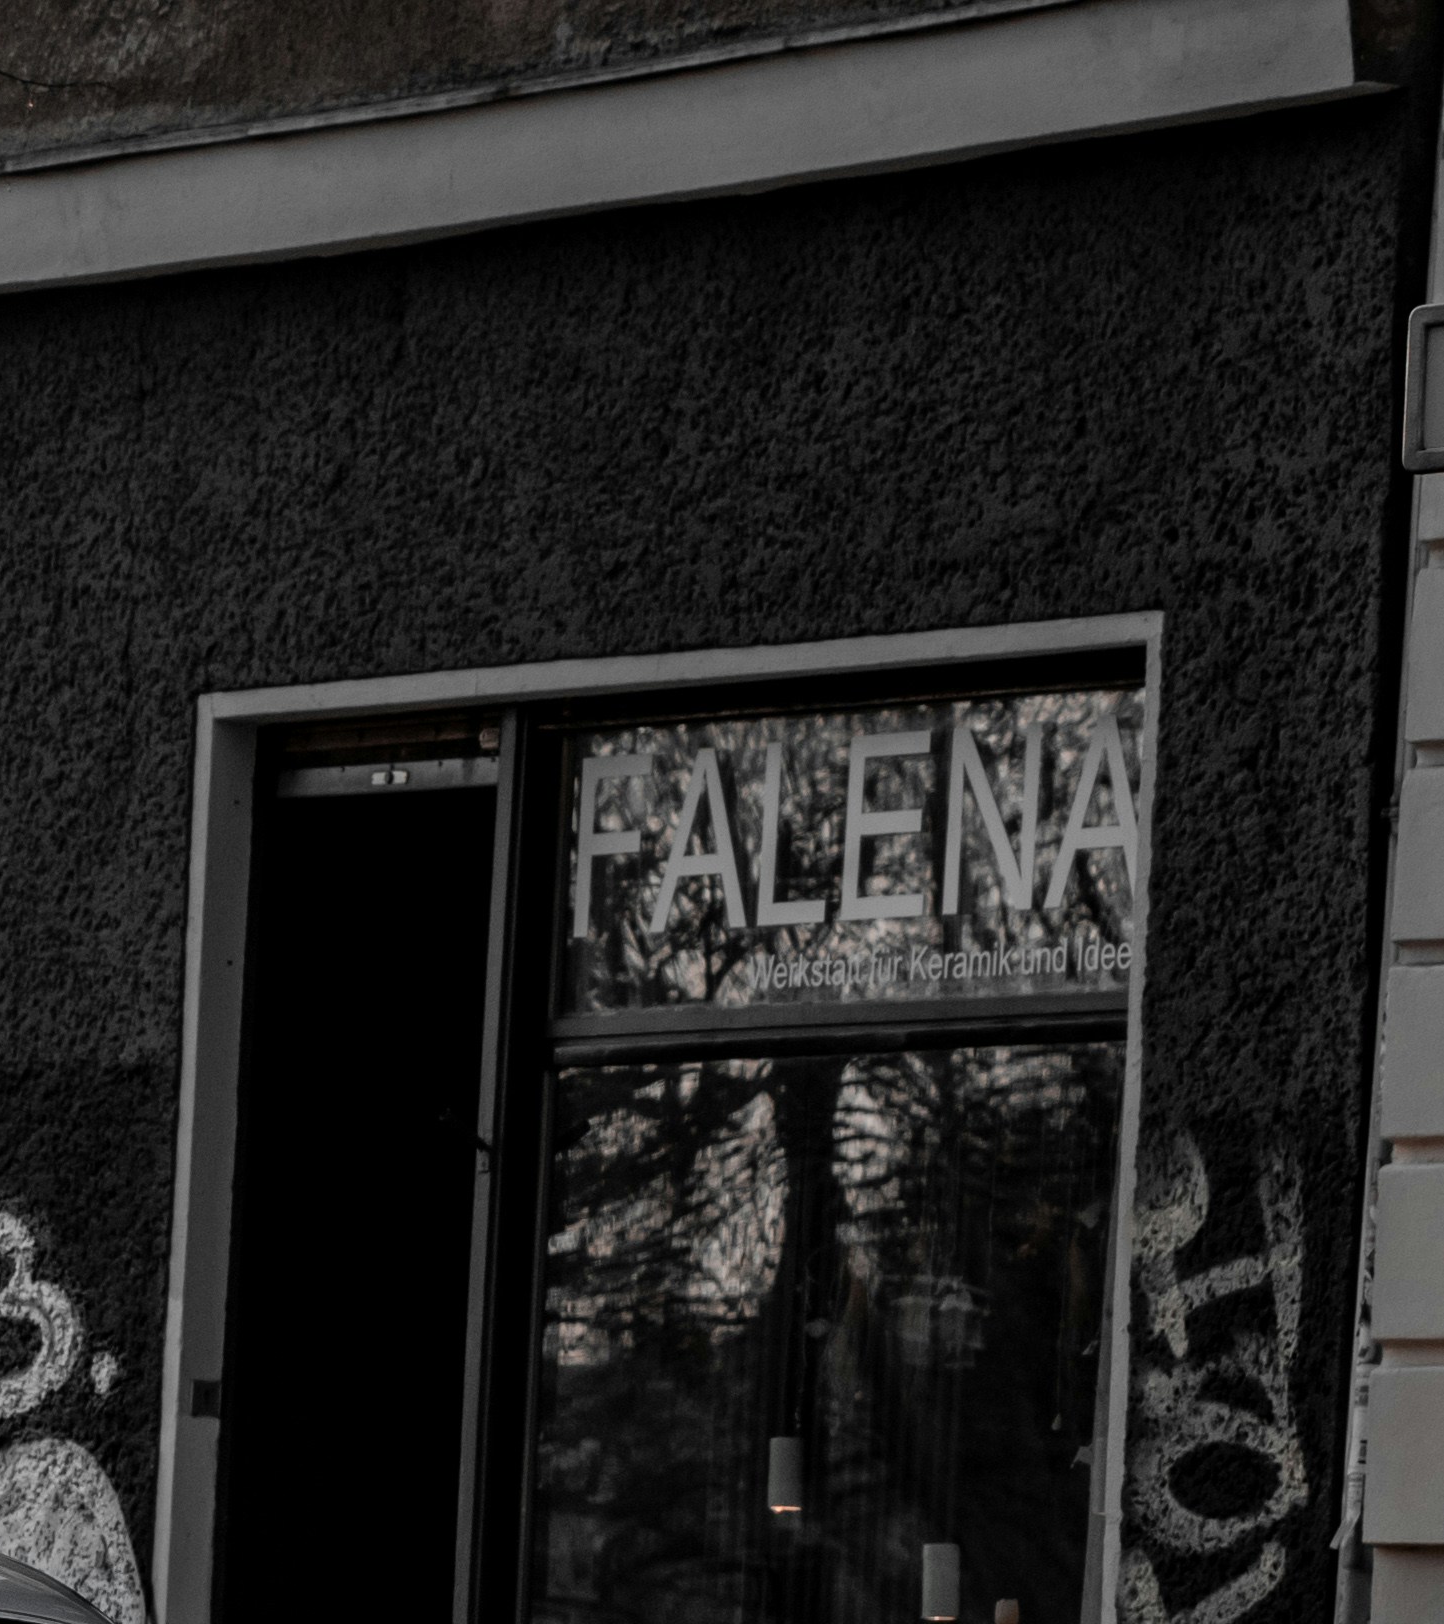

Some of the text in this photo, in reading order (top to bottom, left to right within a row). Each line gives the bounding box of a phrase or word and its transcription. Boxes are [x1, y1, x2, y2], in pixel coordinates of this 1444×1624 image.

[573, 715, 1138, 938] FALENA
[750, 953, 861, 989] Werkstatt
[872, 946, 902, 984] für
[910, 943, 1012, 982] Keramik
[1020, 945, 1066, 975] und
